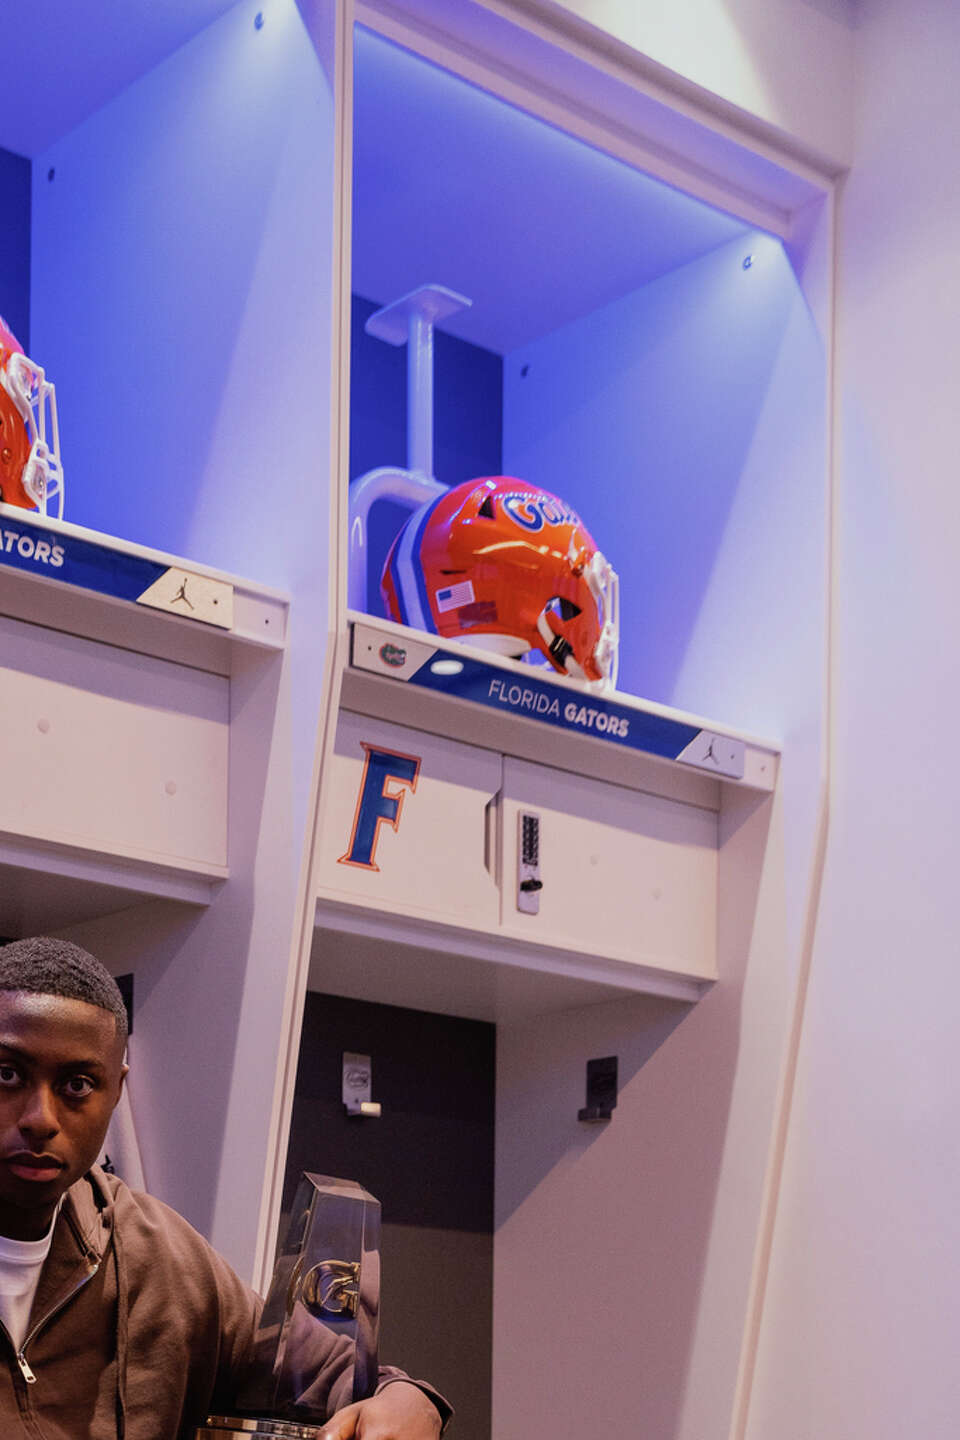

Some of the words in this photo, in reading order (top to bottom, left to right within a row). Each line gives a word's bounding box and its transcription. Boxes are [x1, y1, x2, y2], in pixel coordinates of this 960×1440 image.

[488, 679, 560, 717] FLORIDA
[564, 702, 630, 738] GATORS
[336, 741, 423, 873] F
